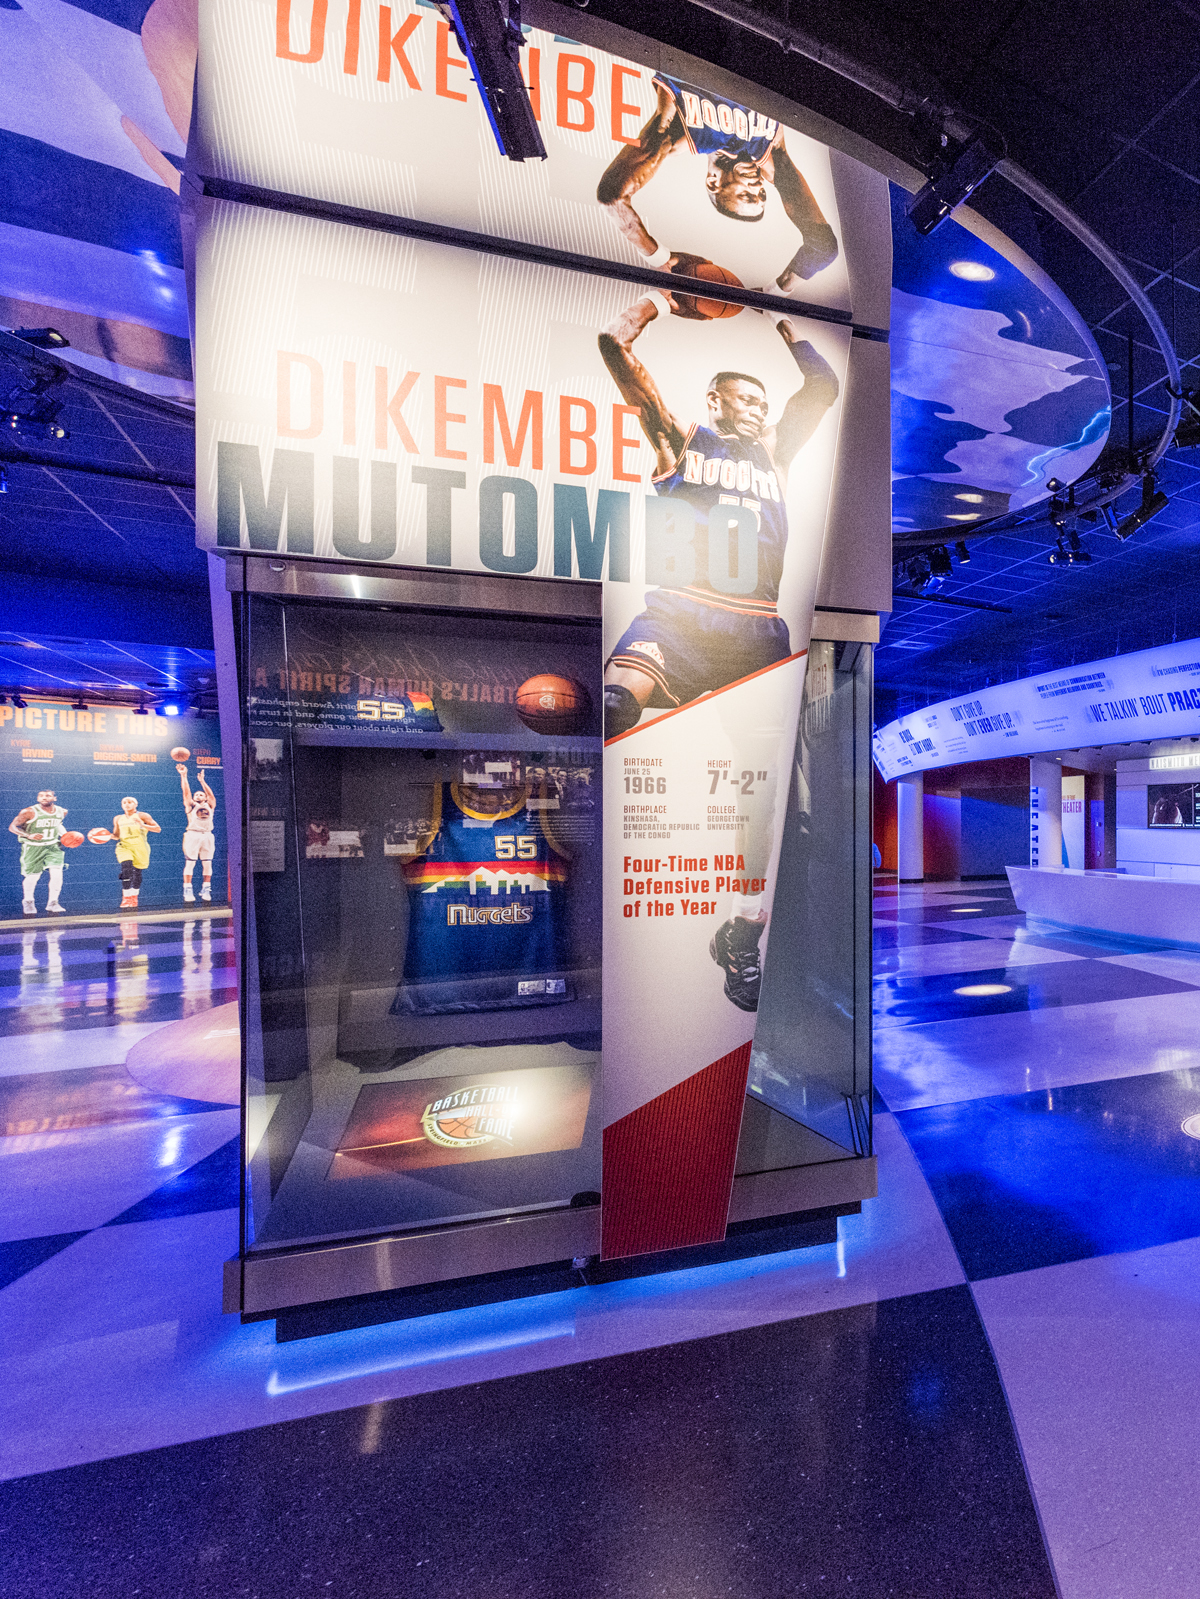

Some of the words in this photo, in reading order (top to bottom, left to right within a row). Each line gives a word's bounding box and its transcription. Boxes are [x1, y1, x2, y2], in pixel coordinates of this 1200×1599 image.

[275, 350, 641, 484] DIKEMBE
[217, 441, 758, 595] MUTOMBO
[357, 700, 405, 721] 55
[1090, 703, 1107, 722] WE
[1104, 698, 1139, 721] TALKIN'
[1139, 693, 1168, 716] BOUT
[0, 705, 107, 733] PICTURE
[115, 713, 168, 737] THIS
[22, 748, 54, 759] IRVING
[93, 752, 157, 763] DIGGINS-SMITH
[196, 756, 221, 765] CURRY
[624, 758, 663, 767] BIRTHDATE
[707, 760, 732, 768] HEIGHT
[1151, 757, 1185, 769] NAISMITH
[624, 777, 666, 794] 1966
[707, 770, 767, 795] 7'-2"
[624, 805, 667, 814] BIRTHPLACE
[707, 806, 736, 814] COLLEGE
[1062, 802, 1082, 813] HEATER
[624, 815, 660, 823] KINSHASA,
[707, 815, 750, 823] GEORGETOWN
[624, 823, 666, 831] DEMOCRATIC
[669, 823, 700, 831] REPUBLIC
[707, 823, 745, 831] UNIVERSITY
[42, 829, 55, 840] 11
[495, 835, 537, 859] 55
[624, 855, 708, 873] Four-Time
[714, 854, 745, 871] NBA
[624, 877, 710, 895] Defensive
[716, 876, 767, 895] Player
[624, 900, 641, 918] of
[647, 900, 674, 917] the
[680, 899, 717, 916] Year
[432, 1086, 518, 1112] BASKETBALL
[479, 1117, 515, 1140] FAME
